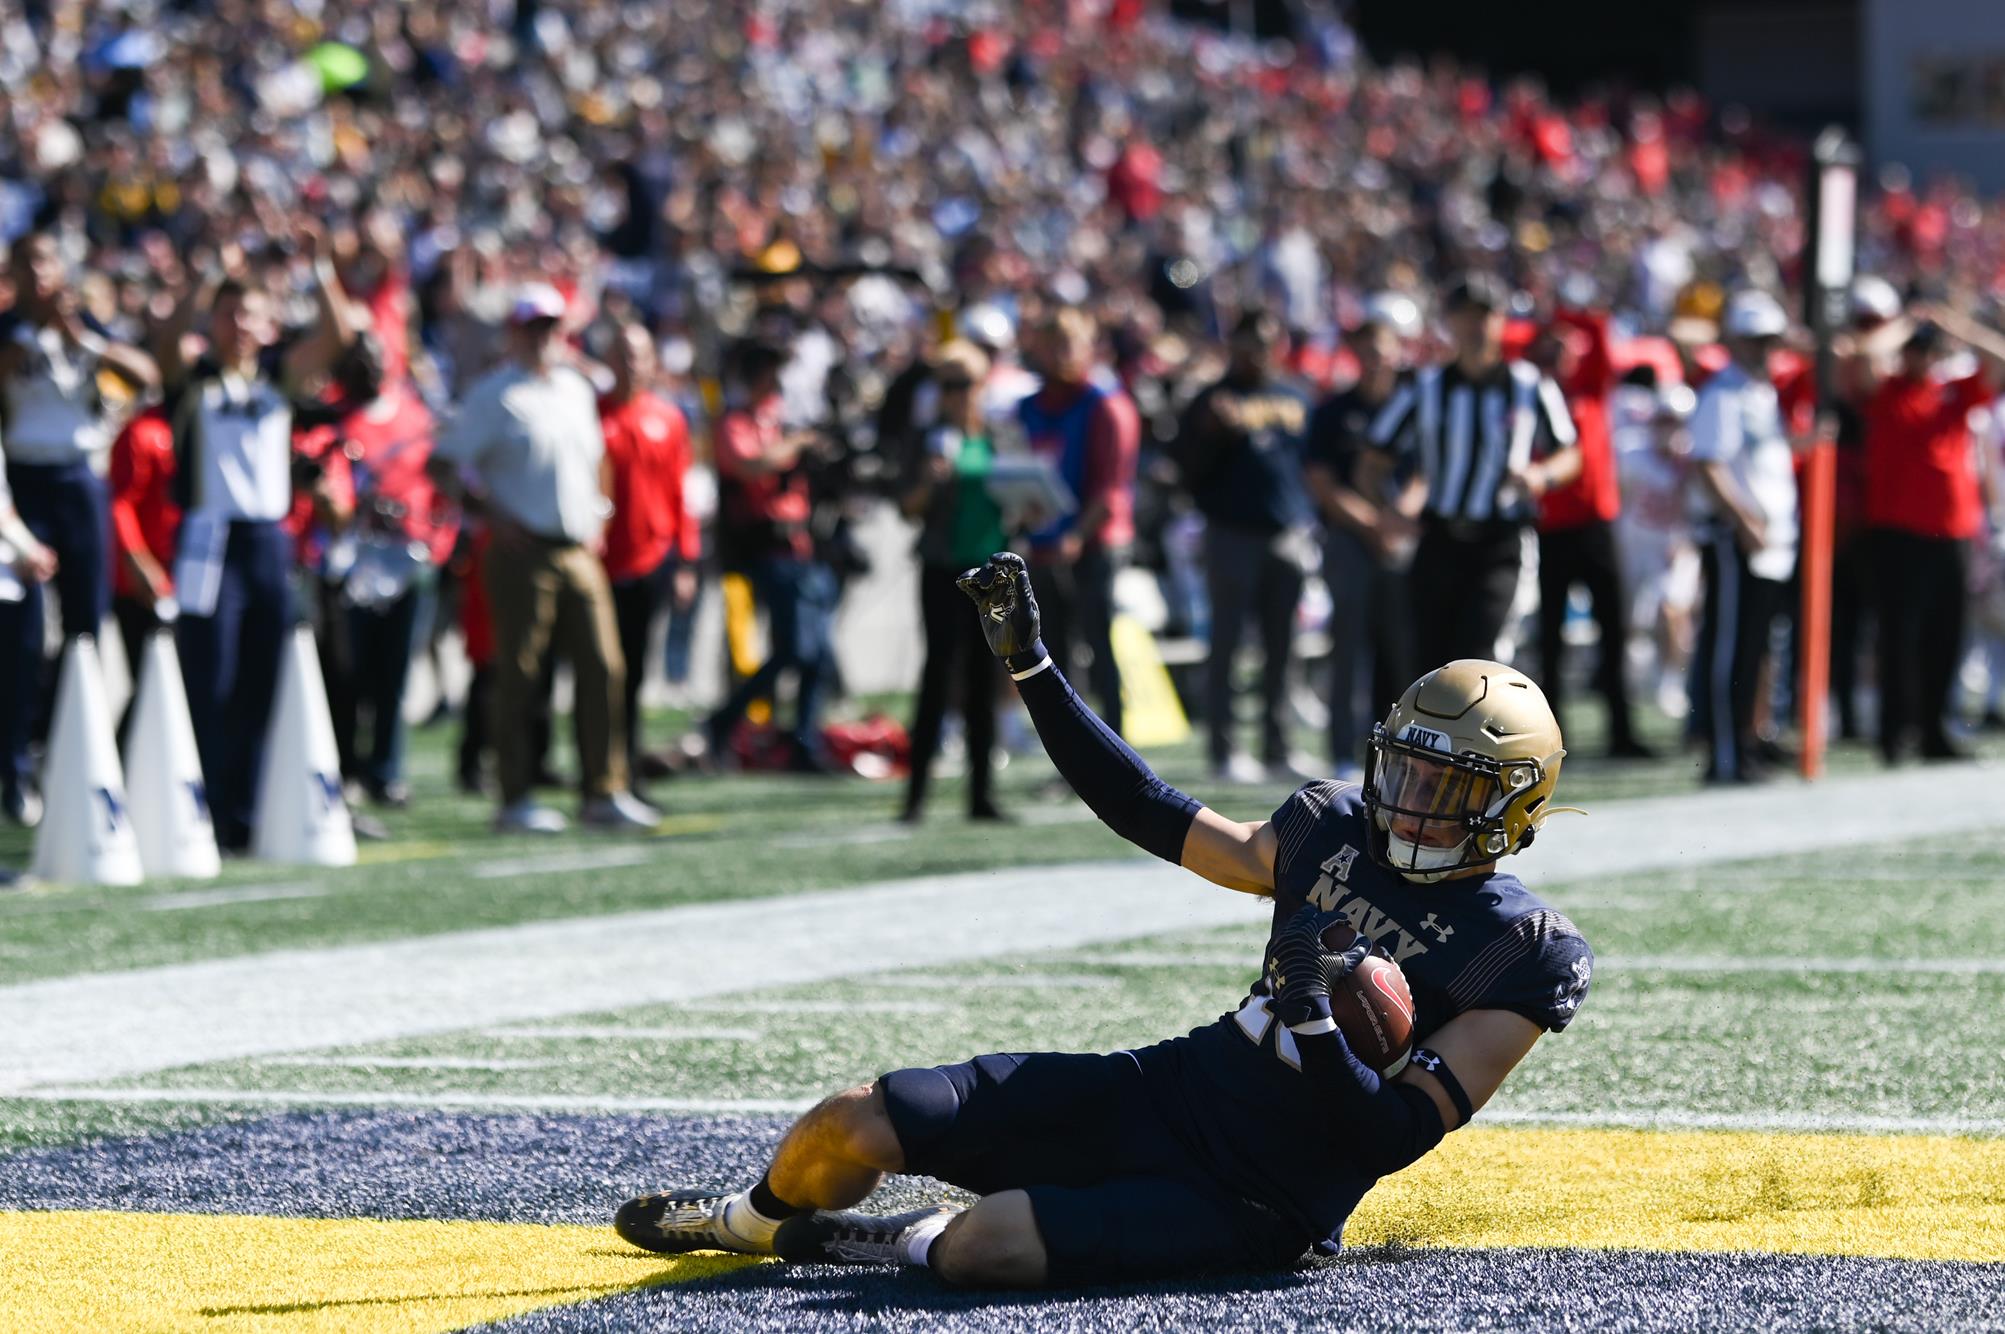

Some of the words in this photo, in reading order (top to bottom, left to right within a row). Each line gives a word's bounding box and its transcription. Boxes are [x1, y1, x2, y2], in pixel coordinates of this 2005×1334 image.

[1405, 726, 1440, 748] NAVY
[1320, 843, 1360, 882] A
[1306, 872, 1429, 964] NAVY
